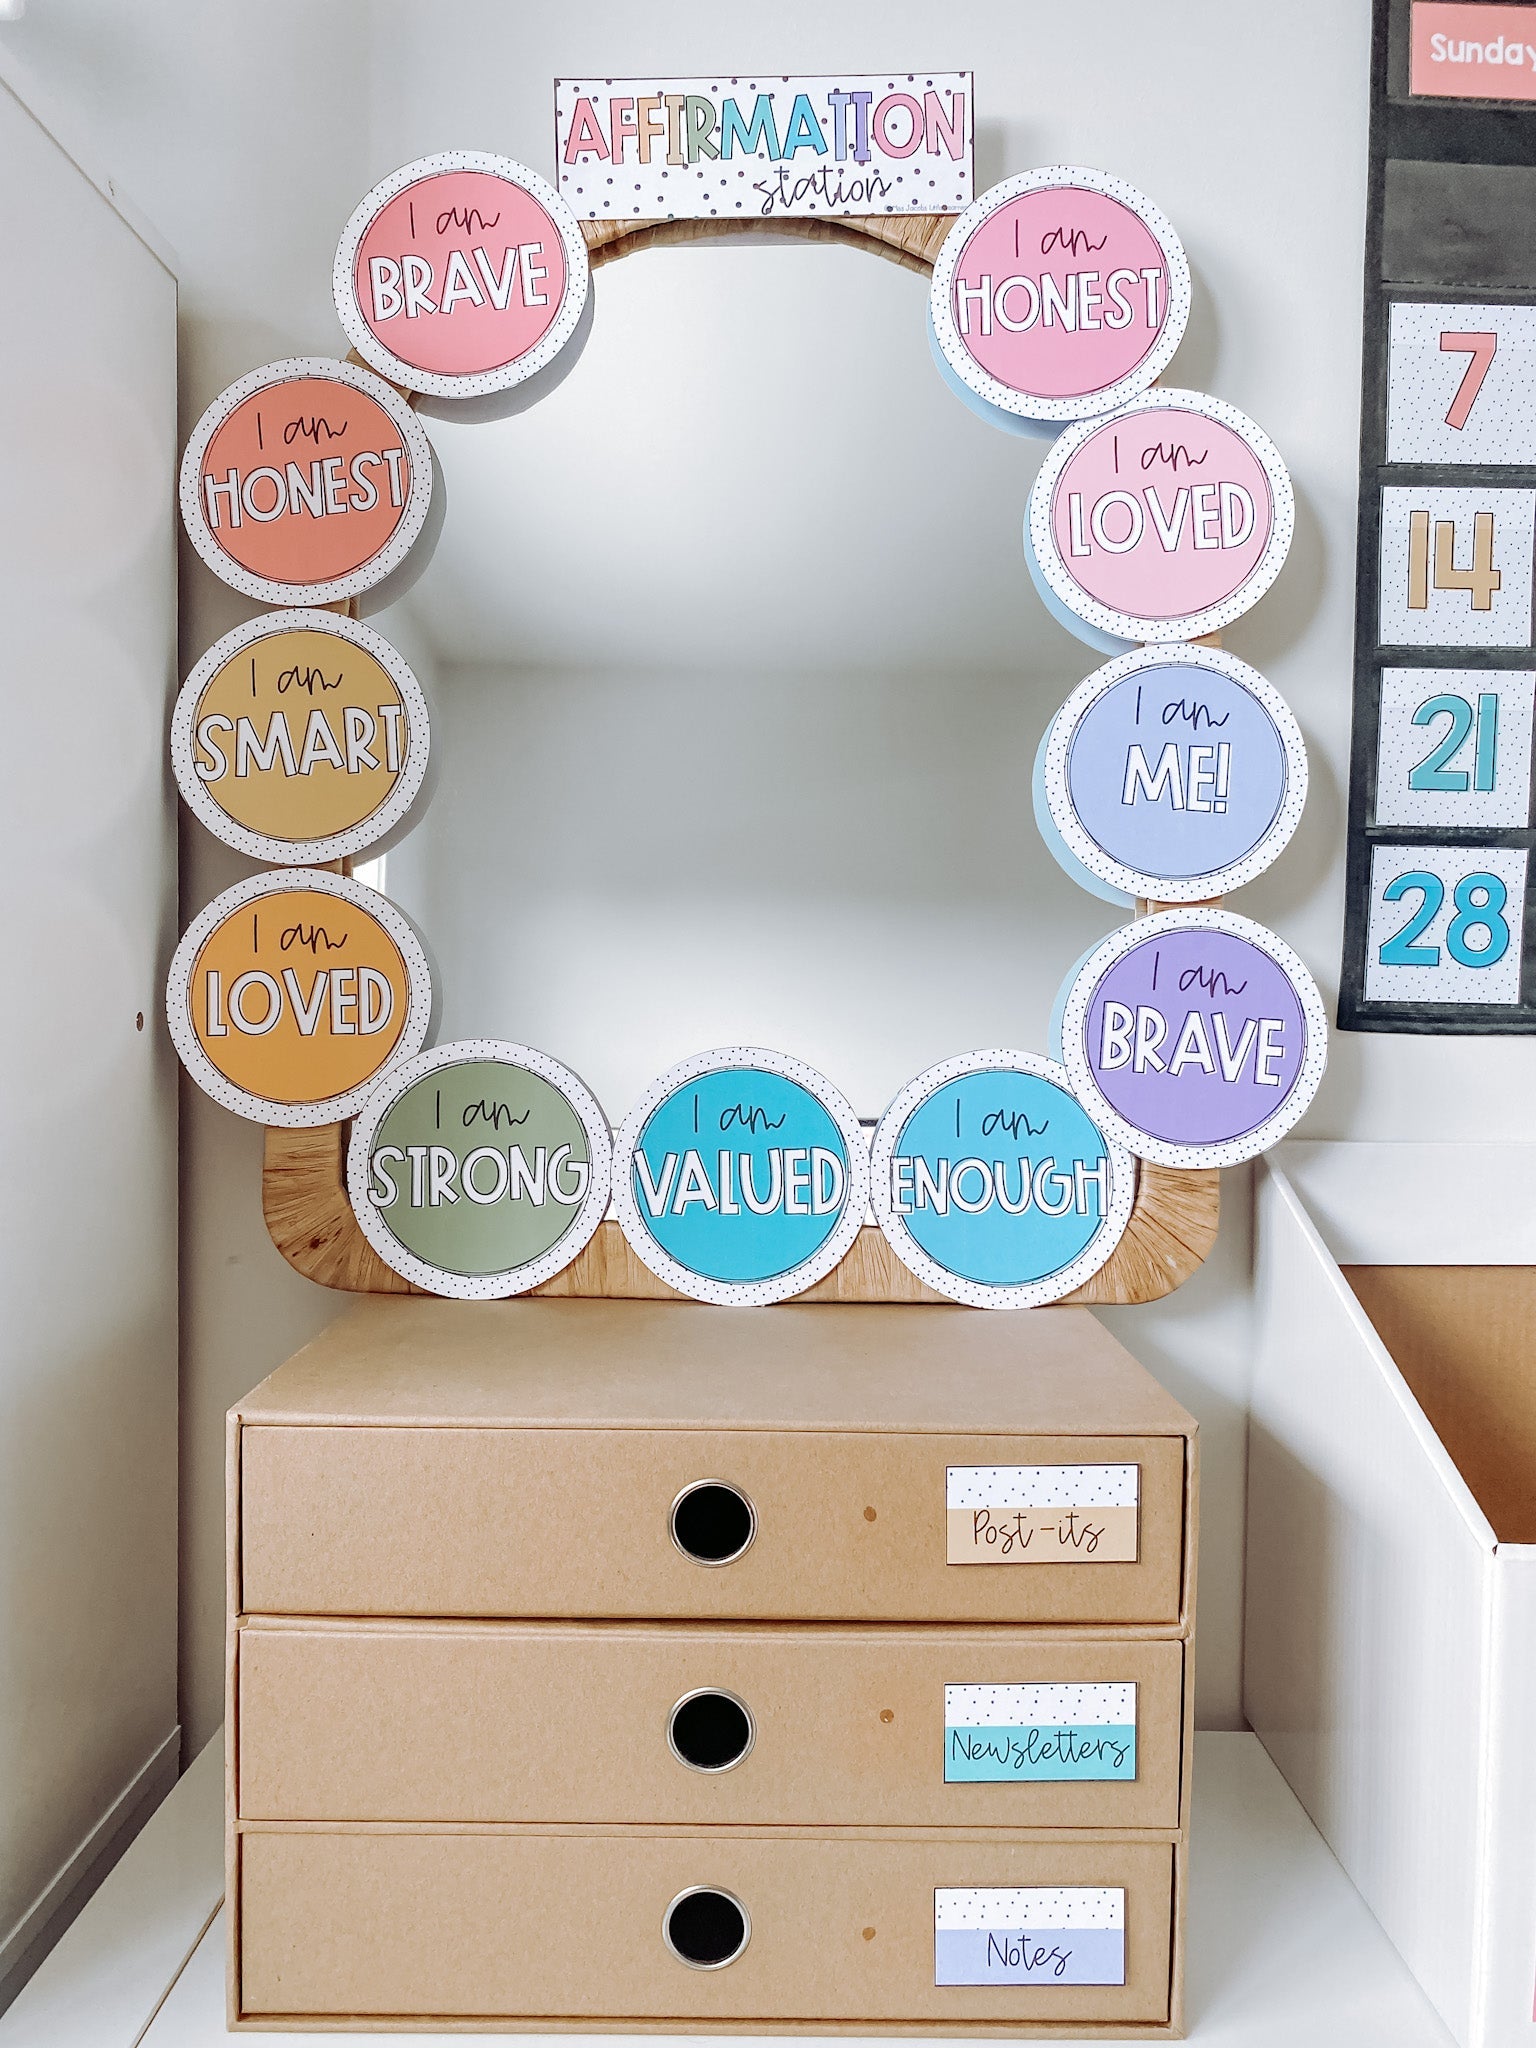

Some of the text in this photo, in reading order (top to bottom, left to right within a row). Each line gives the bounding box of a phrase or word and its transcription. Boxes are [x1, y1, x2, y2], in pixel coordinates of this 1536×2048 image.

[564, 91, 965, 165] AFFIRMATION
[409, 202, 500, 239] I am
[756, 165, 892, 214] station
[1014, 219, 1107, 258] I am
[369, 242, 549, 322] BRAVE
[955, 267, 1163, 337] HONEST
[1440, 331, 1497, 431] 7
[257, 412, 348, 450] I am
[1114, 435, 1208, 474] I am
[203, 447, 405, 529] HONEST
[1068, 481, 1255, 557] LOVED
[1407, 510, 1501, 611] 14
[251, 658, 343, 697] I am
[1136, 685, 1230, 730] I am
[193, 703, 402, 783] SMART
[1408, 693, 1499, 791] 21
[1121, 742, 1231, 814] ME!
[253, 914, 349, 953] I am
[1378, 870, 1511, 968] 28
[206, 966, 394, 1037] LOVED
[1152, 951, 1248, 998] I am
[1098, 1000, 1286, 1087] BRAVE
[436, 1090, 530, 1129] I am
[694, 1096, 787, 1134] I am
[956, 1097, 1049, 1136] I am
[368, 1144, 591, 1210] STRONG
[631, 1147, 845, 1219] VALUED
[890, 1149, 1111, 1219] ENOUGH
[973, 1509, 1106, 1554] Post-its
[952, 1728, 1131, 1766] Newsletters
[987, 1933, 1073, 1976] Notes
